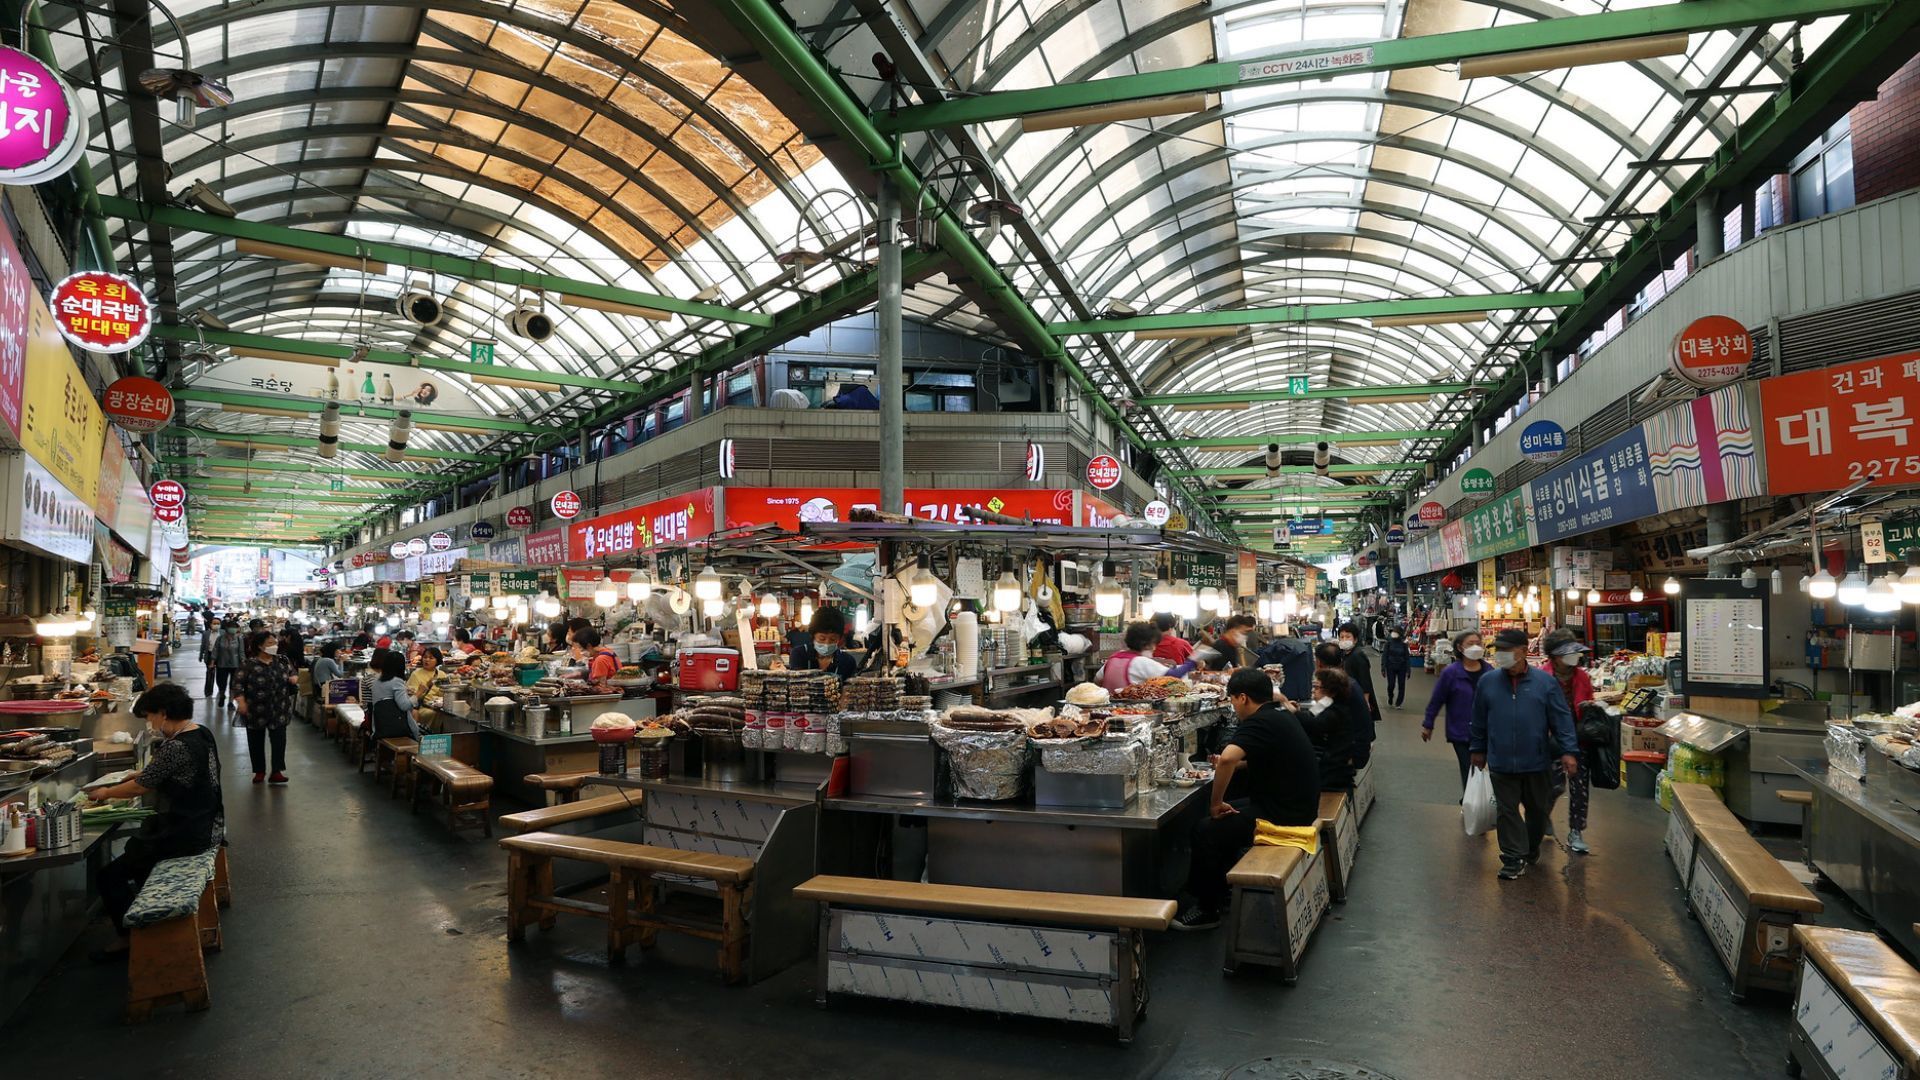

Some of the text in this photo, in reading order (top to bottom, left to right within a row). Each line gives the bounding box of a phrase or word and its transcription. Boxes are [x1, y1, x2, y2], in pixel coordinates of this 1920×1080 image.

[1263, 52, 1364, 75] CCTV 24시간 녹화중
[76, 279, 129, 301] 육회
[61, 294, 142, 323] 순대국밥
[70, 316, 131, 339] 빈대떡
[1681, 334, 1748, 359] 대복상회
[1698, 366, 1740, 378] 2275-4324
[1832, 366, 1884, 395] 건과
[251, 377, 293, 394] 국순당
[109, 390, 170, 416] 광장순대
[1522, 431, 1563, 449] 성미식품
[1609, 442, 1643, 474] 일회용품
[1463, 477, 1493, 489] 동명홍삼
[1553, 458, 1609, 516] 성미식품
[154, 494, 181, 503] 빈대떡
[766, 497, 800, 505] Since 1975
[1420, 506, 1443, 519] 신안상회
[1474, 499, 1514, 544] 동명홍삼
[597, 520, 634, 553] 모녀김밥
[653, 508, 688, 545] 빈대떡
[1867, 539, 1880, 547] 62
[1191, 564, 1223, 578] 잔치국수
[501, 579, 539, 590] 순대아줌마
